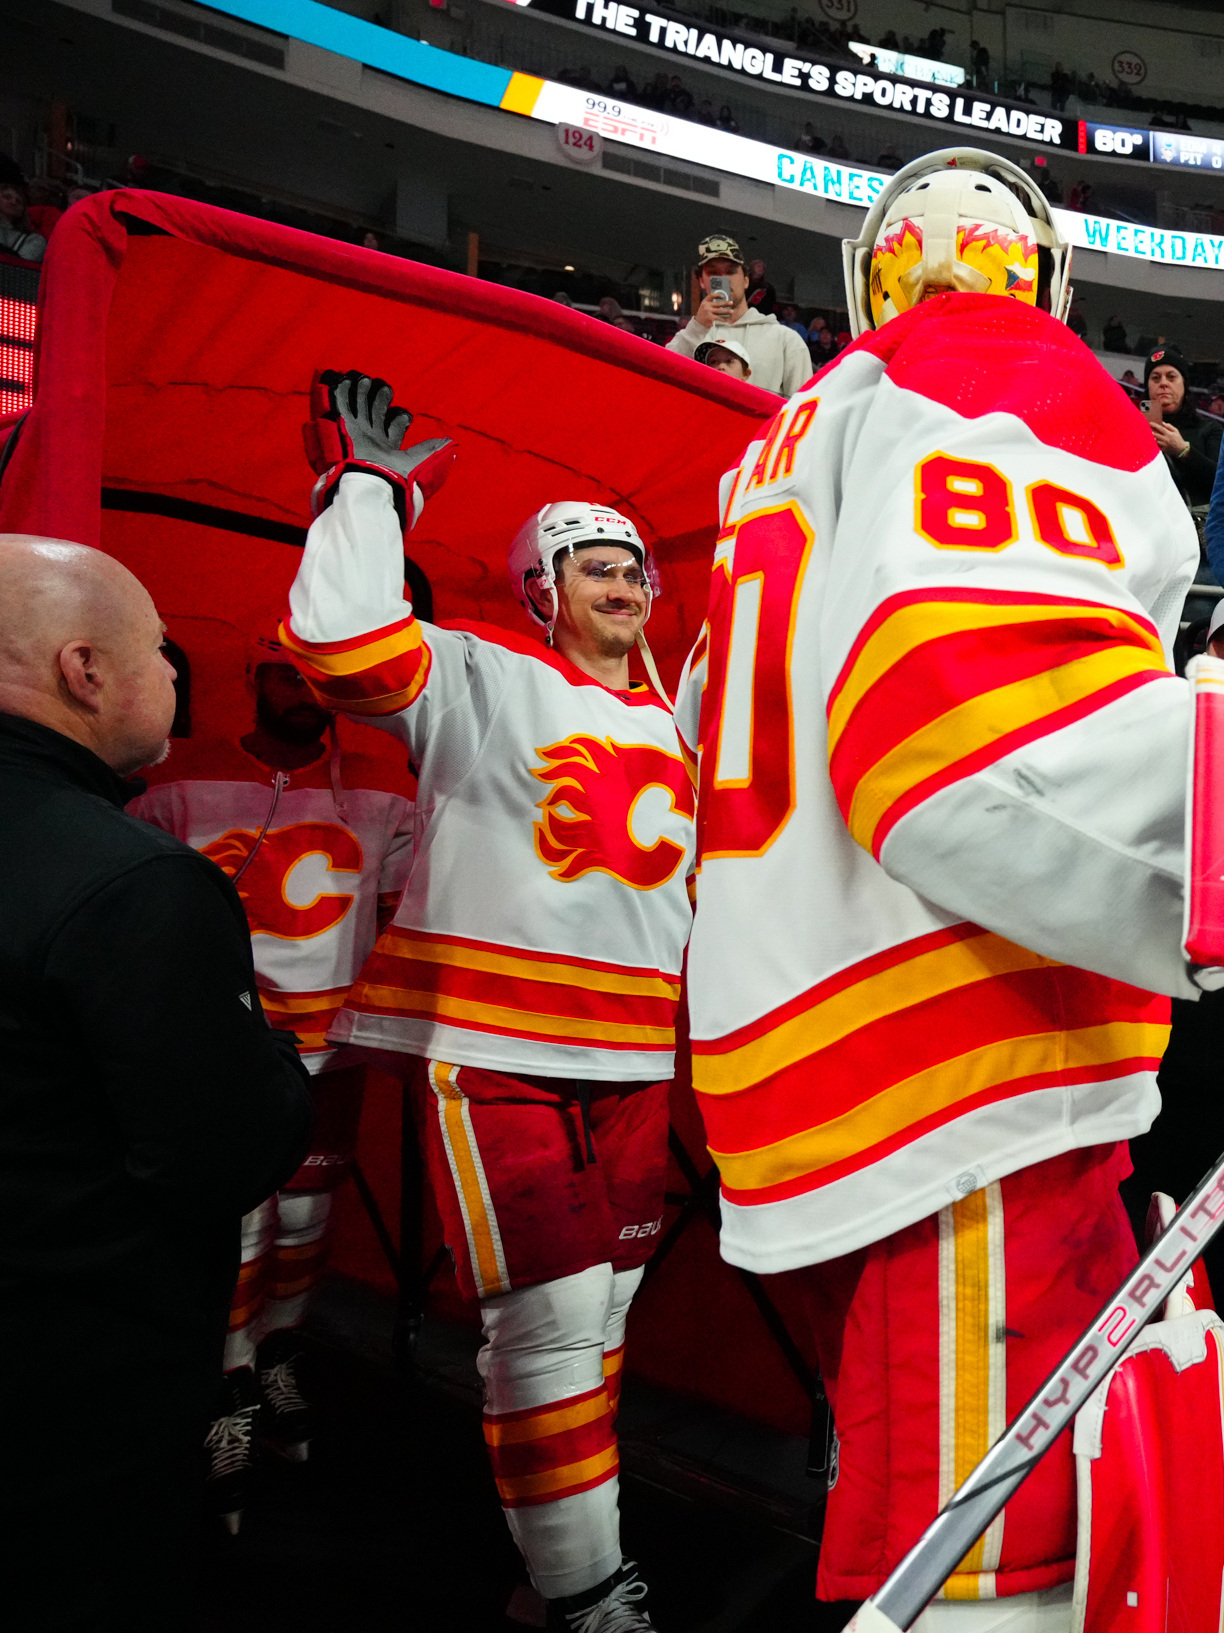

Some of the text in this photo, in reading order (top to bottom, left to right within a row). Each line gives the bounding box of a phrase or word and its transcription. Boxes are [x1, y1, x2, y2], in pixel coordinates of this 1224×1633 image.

[575, 0, 640, 37] THE
[644, 13, 830, 92] TRIANGLE'S
[834, 70, 950, 118] SPORTS
[953, 98, 1062, 144] LEADER
[1117, 60, 1143, 76] 332
[586, 97, 622, 118] 99.9
[582, 110, 658, 145] ESPN
[563, 128, 595, 151] 124
[1180, 152, 1204, 166] PIT
[777, 153, 885, 203] CANES
[1084, 218, 1224, 264] WEEKDAY
[594, 516, 626, 525] CCM
[914, 450, 1125, 570] 80
